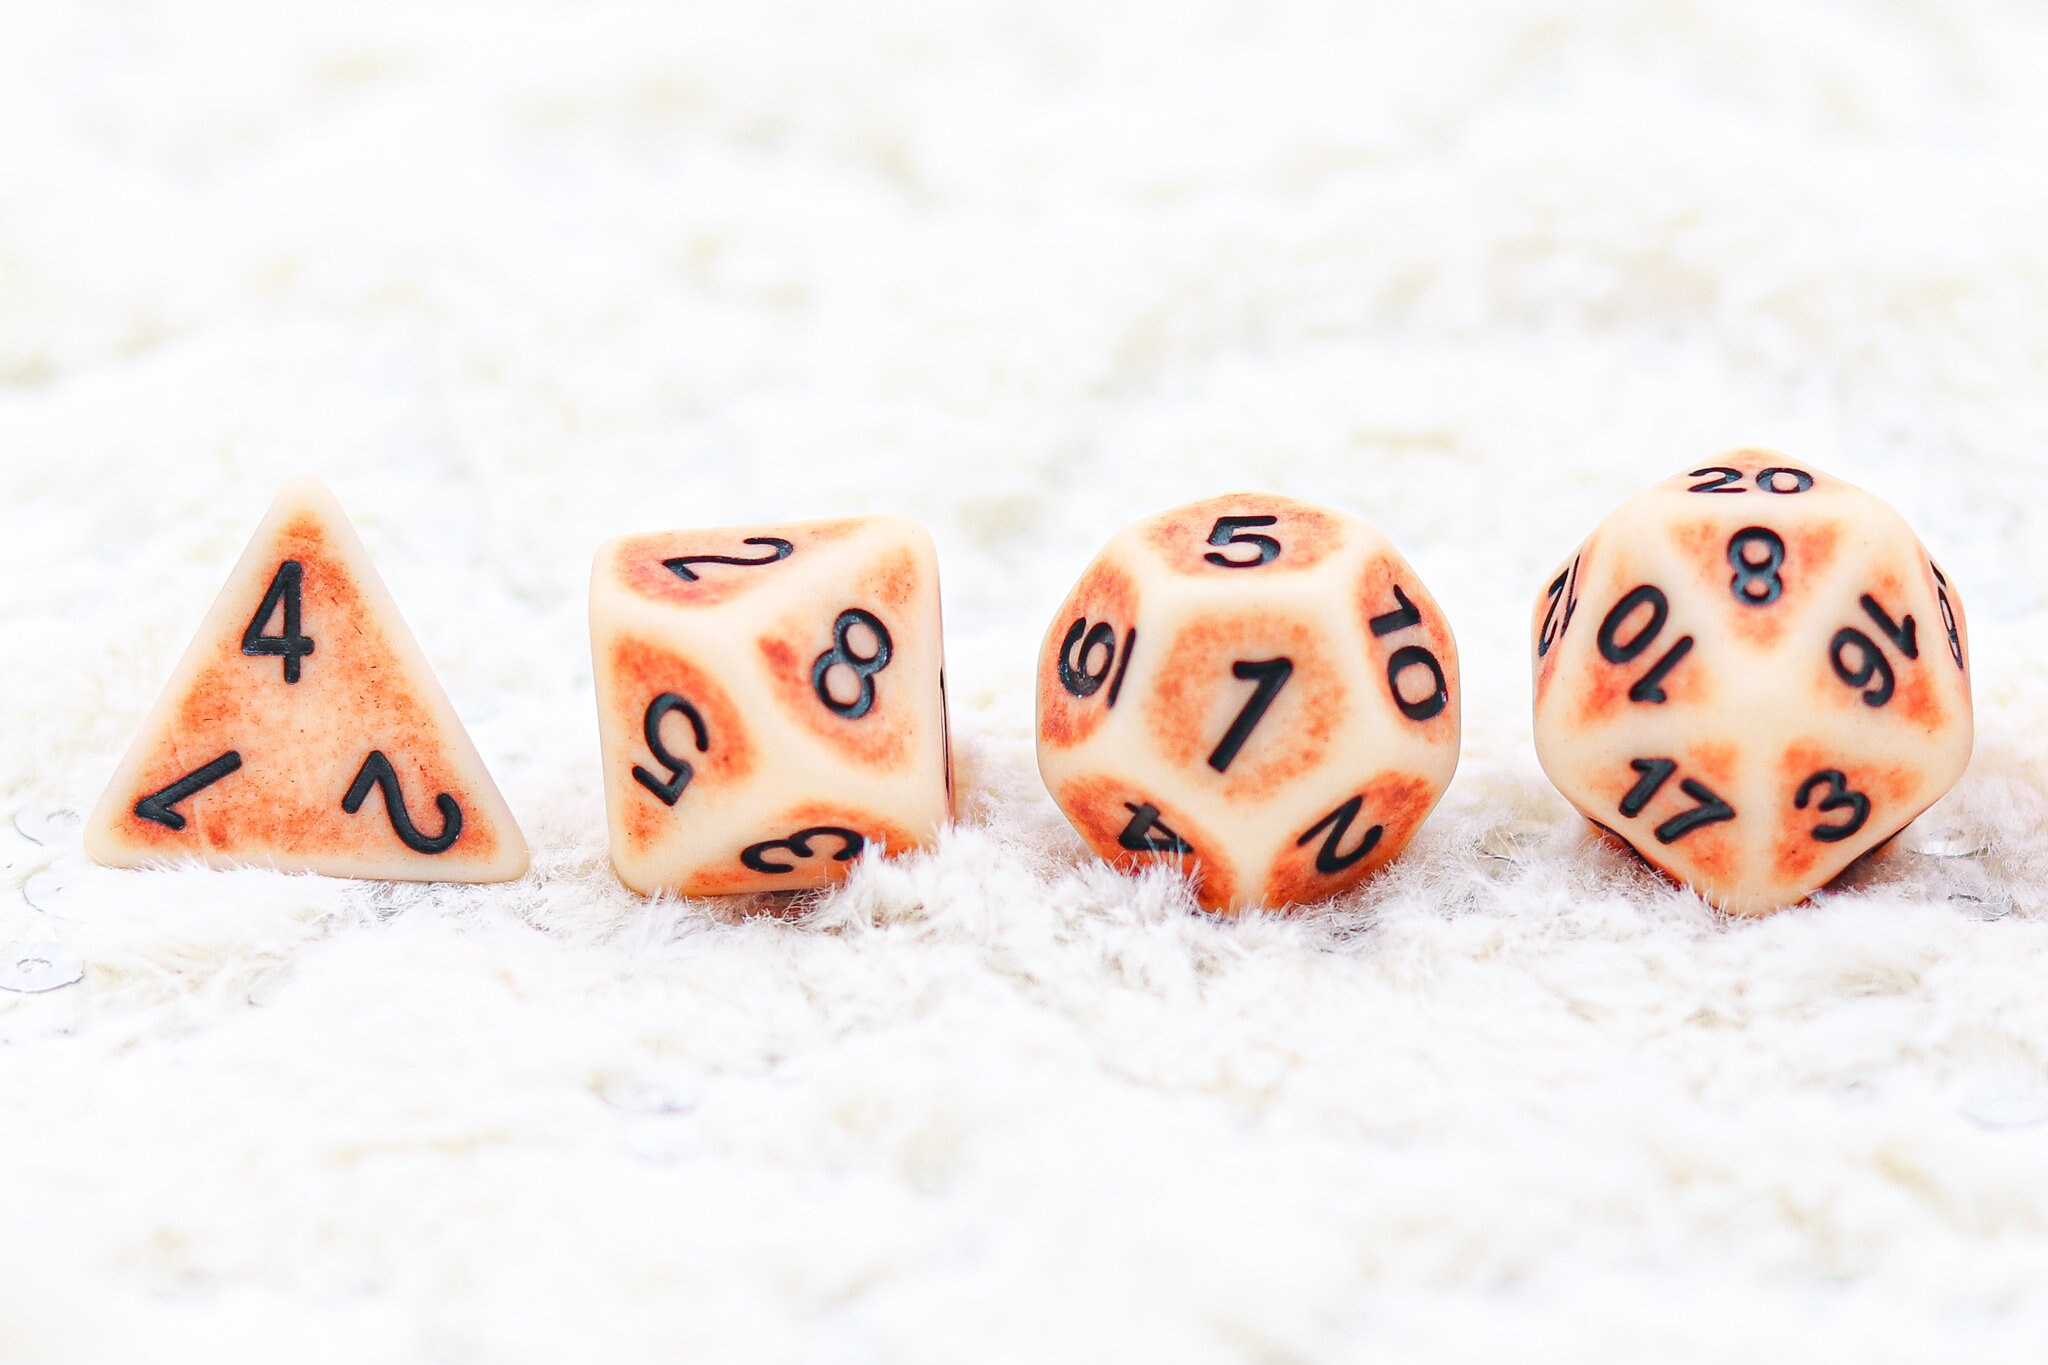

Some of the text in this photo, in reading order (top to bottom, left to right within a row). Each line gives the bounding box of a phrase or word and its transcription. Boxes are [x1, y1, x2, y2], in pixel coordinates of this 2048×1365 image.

[1687, 466, 1815, 494] 20
[661, 536, 795, 582] 2
[1203, 514, 1282, 568] 5
[1726, 526, 1786, 606] 8
[240, 559, 316, 685] 4
[1369, 584, 1450, 722] 10
[1596, 583, 1695, 704] 10
[1829, 593, 1920, 708] 16
[812, 607, 894, 720] 8
[133, 750, 243, 832] 1
[631, 692, 710, 808] 5
[340, 749, 464, 856] 2
[1116, 801, 1195, 855] 4
[1296, 794, 1385, 876] 2
[1618, 757, 1737, 846] 17
[1793, 769, 1872, 844] 3
[739, 825, 866, 875] 3
